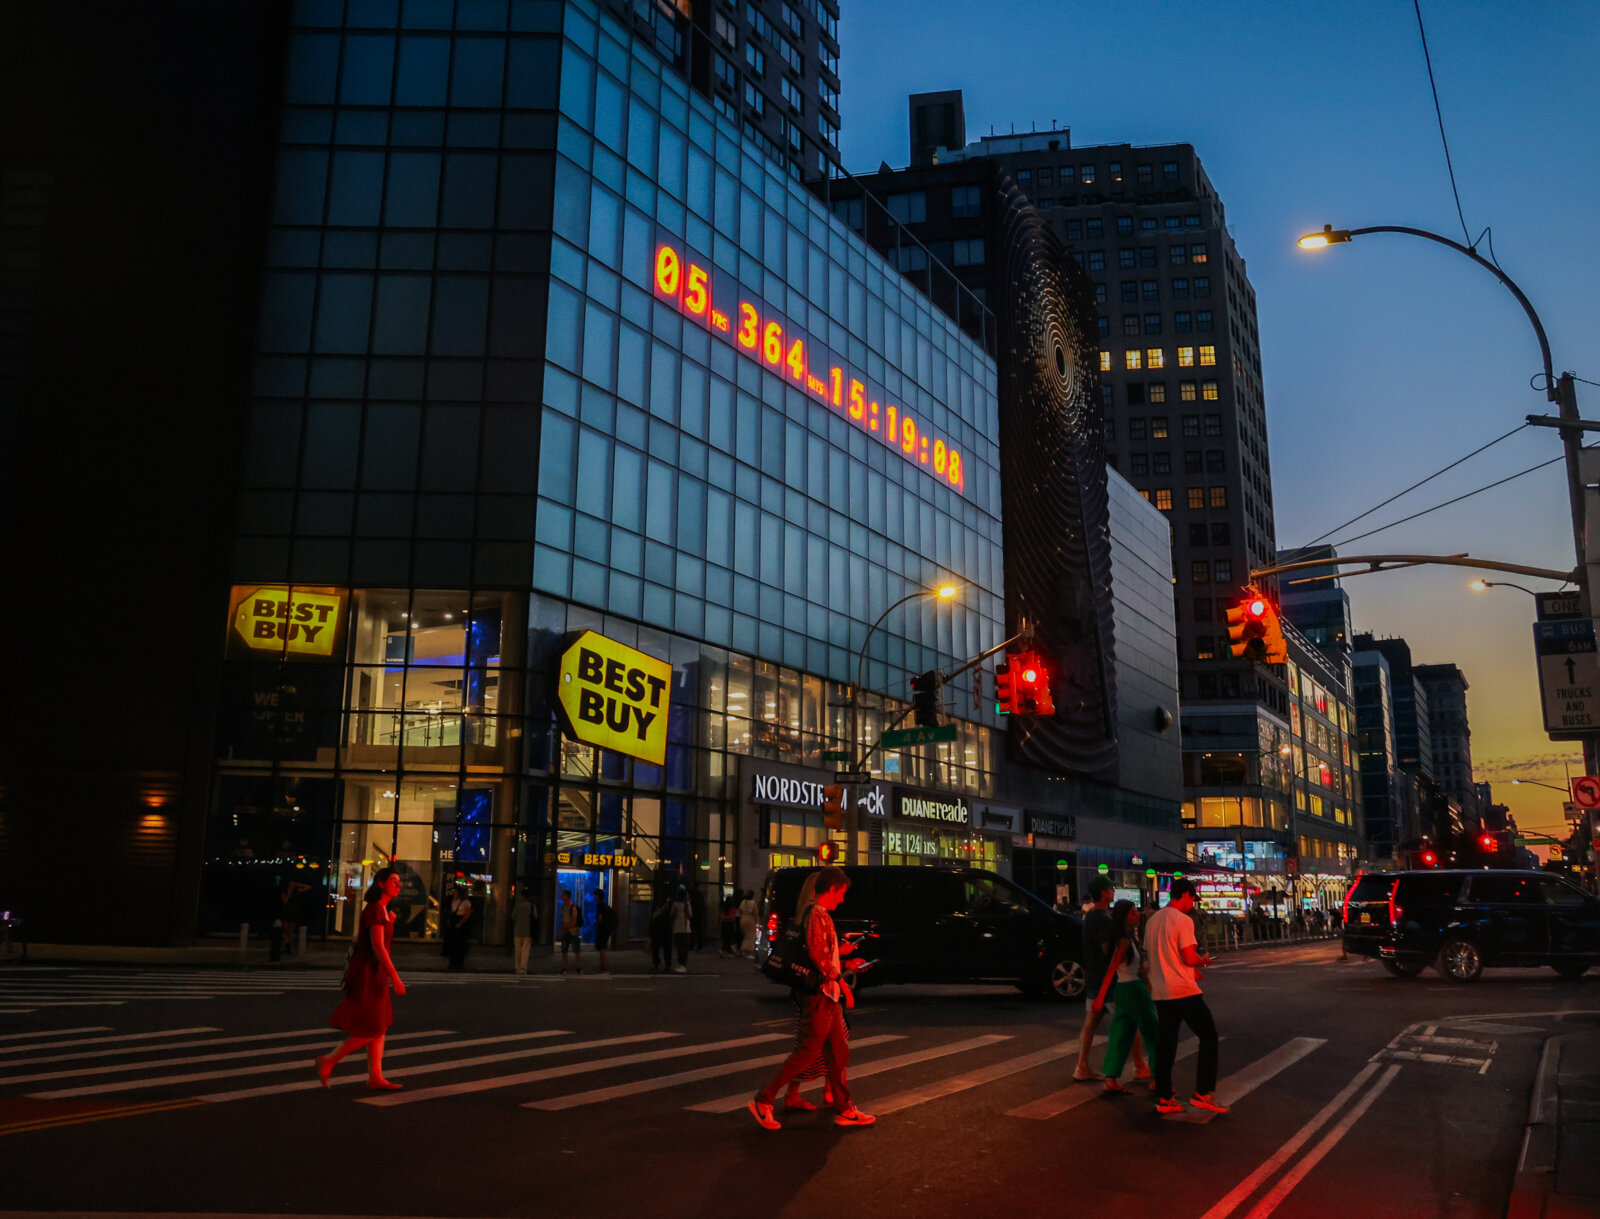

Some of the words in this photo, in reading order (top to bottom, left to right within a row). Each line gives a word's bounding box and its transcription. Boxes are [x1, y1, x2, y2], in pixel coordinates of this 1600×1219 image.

[656, 246, 708, 313] 05
[711, 309, 728, 331] YRS
[738, 302, 804, 379] 364
[832, 367, 960, 484] 15:19:08
[253, 599, 333, 623] BEST
[1551, 601, 1582, 612] ONE
[254, 620, 324, 643] BUY
[1562, 623, 1587, 635] BUS
[1568, 640, 1593, 652] 6AM
[578, 646, 666, 708] BEST
[254, 691, 281, 707] WE
[1557, 687, 1593, 699] TRUCKS
[1566, 701, 1585, 712] AND
[578, 687, 656, 741] BUY
[1562, 714, 1593, 726] BUSES
[583, 853, 613, 866] BEST
[614, 856, 638, 867] BUY
